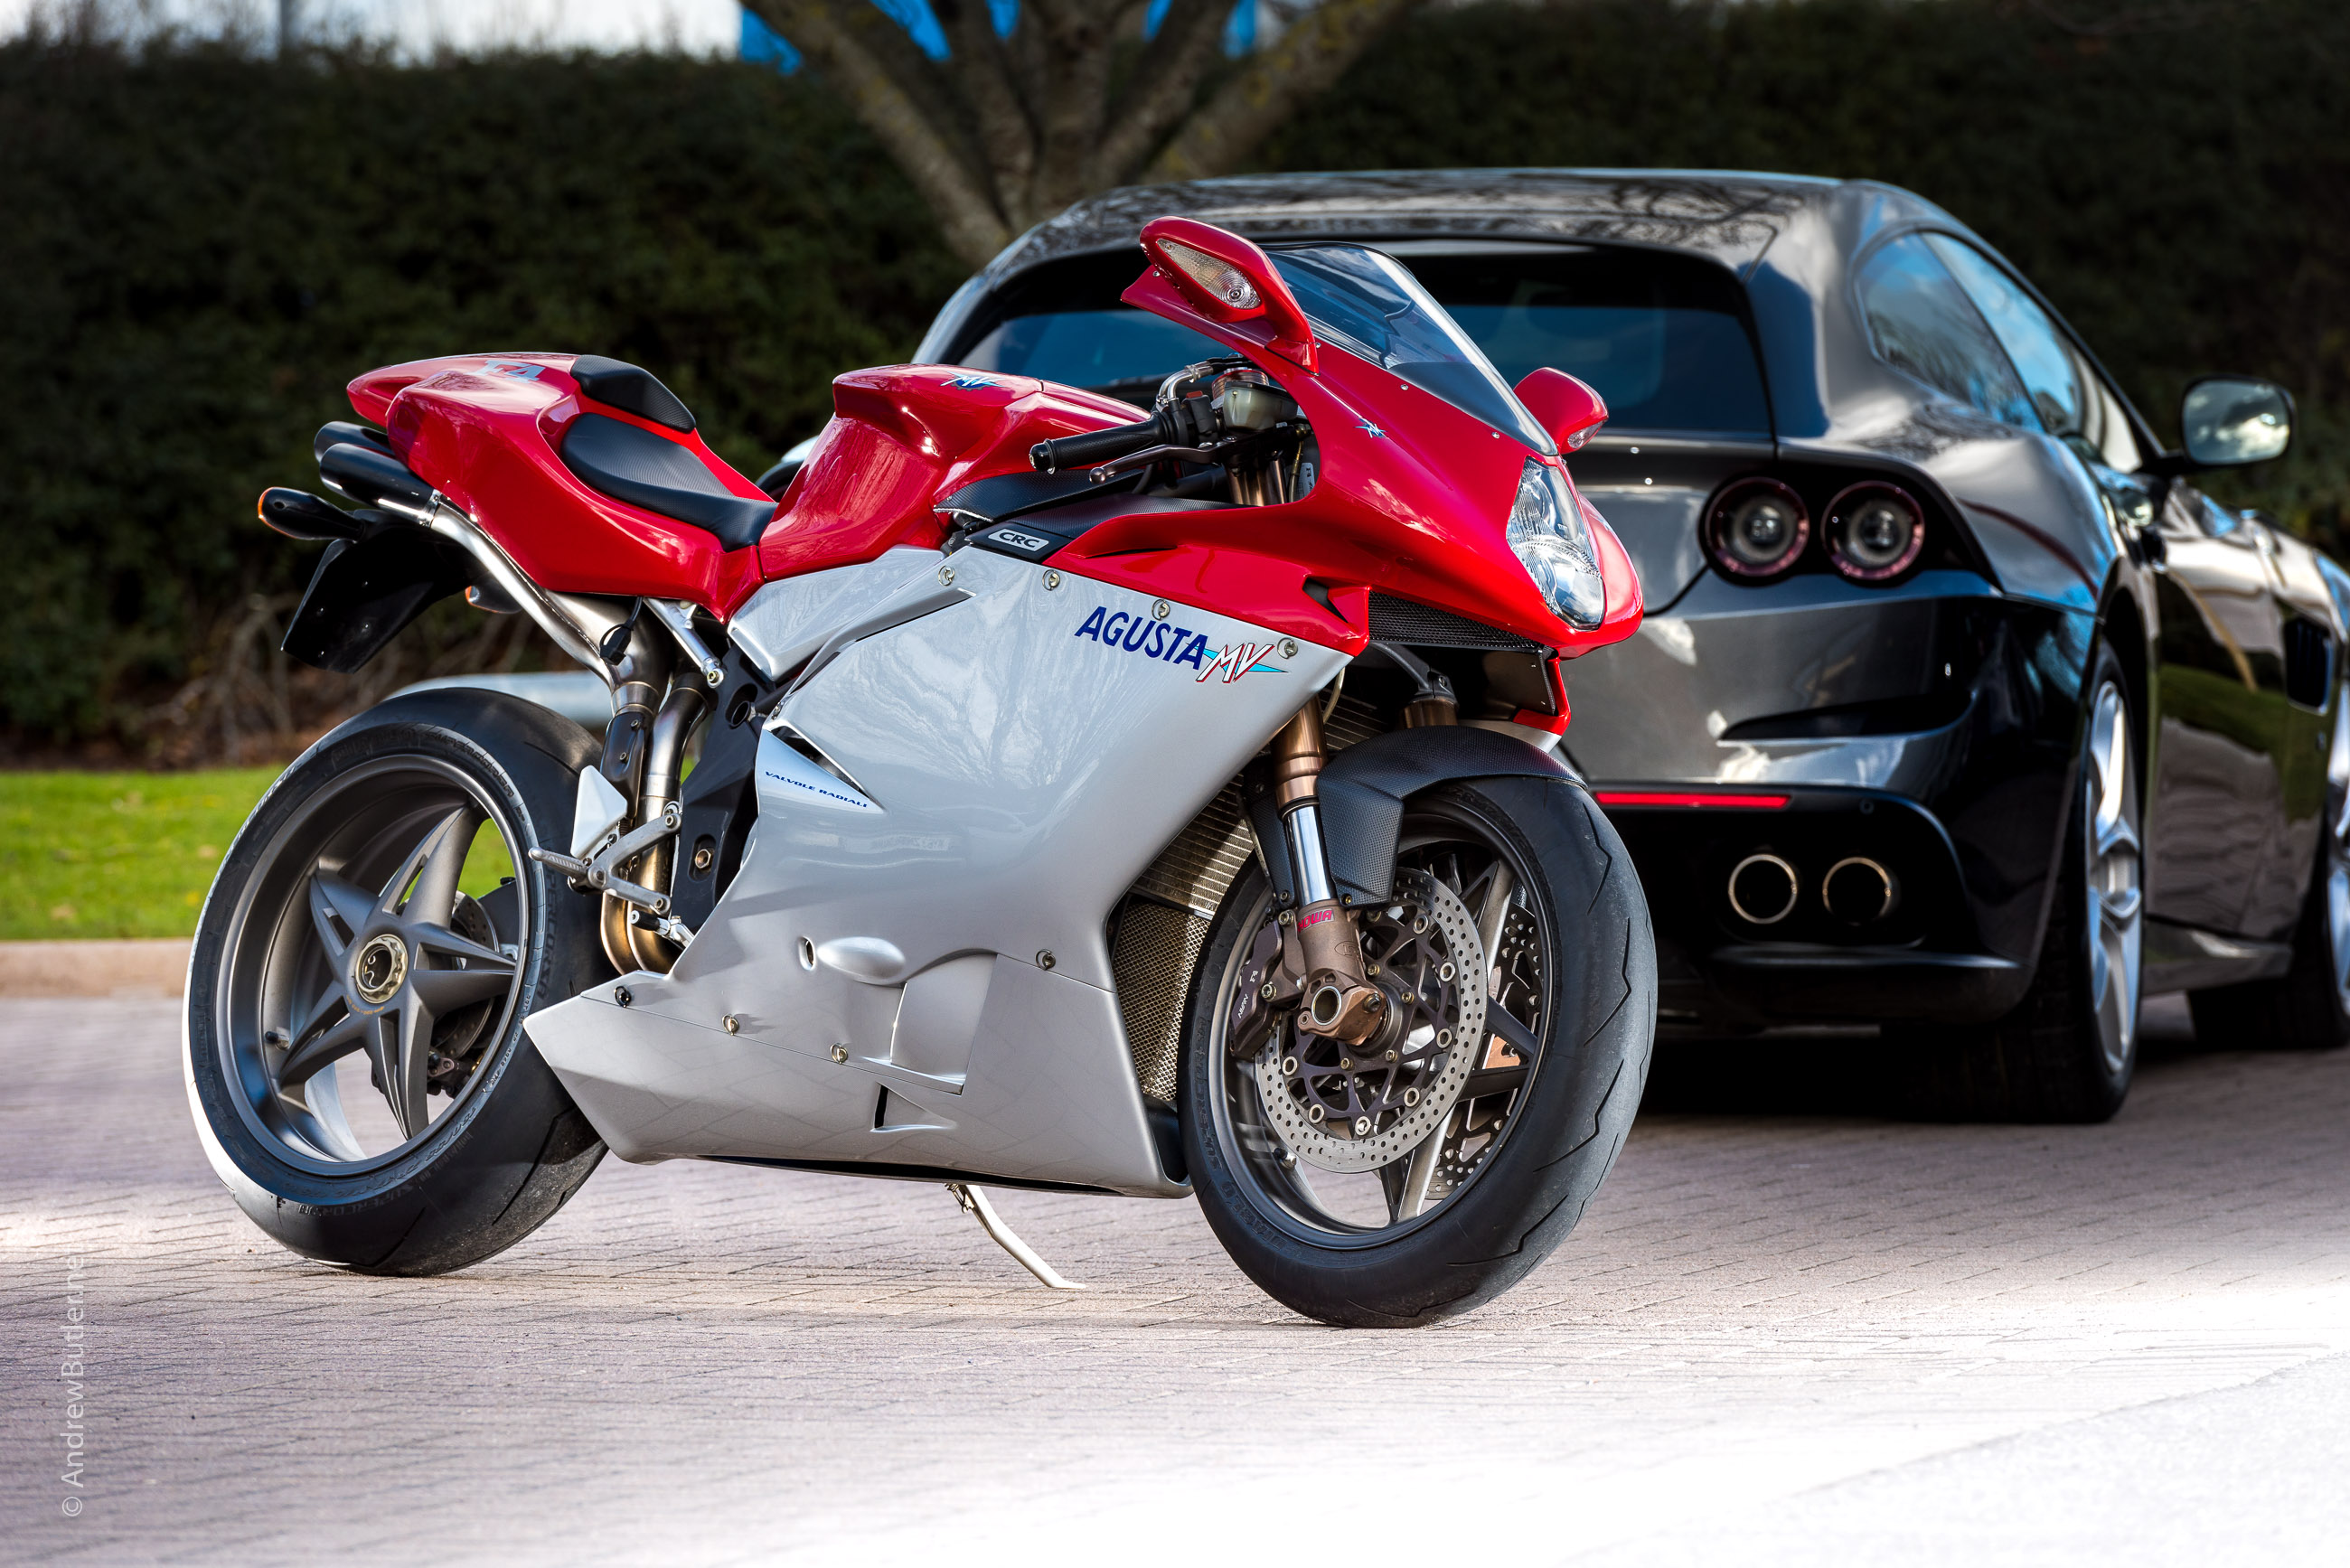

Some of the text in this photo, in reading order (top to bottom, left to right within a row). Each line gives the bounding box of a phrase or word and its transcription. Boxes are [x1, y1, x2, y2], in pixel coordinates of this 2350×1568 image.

[465, 360, 546, 384] F4
[999, 531, 1039, 548] CRC
[1074, 606, 1275, 683] AGUSTA MV
[765, 771, 868, 808] VALVOLE RADIALI
[1296, 909, 1333, 933] HOWA
